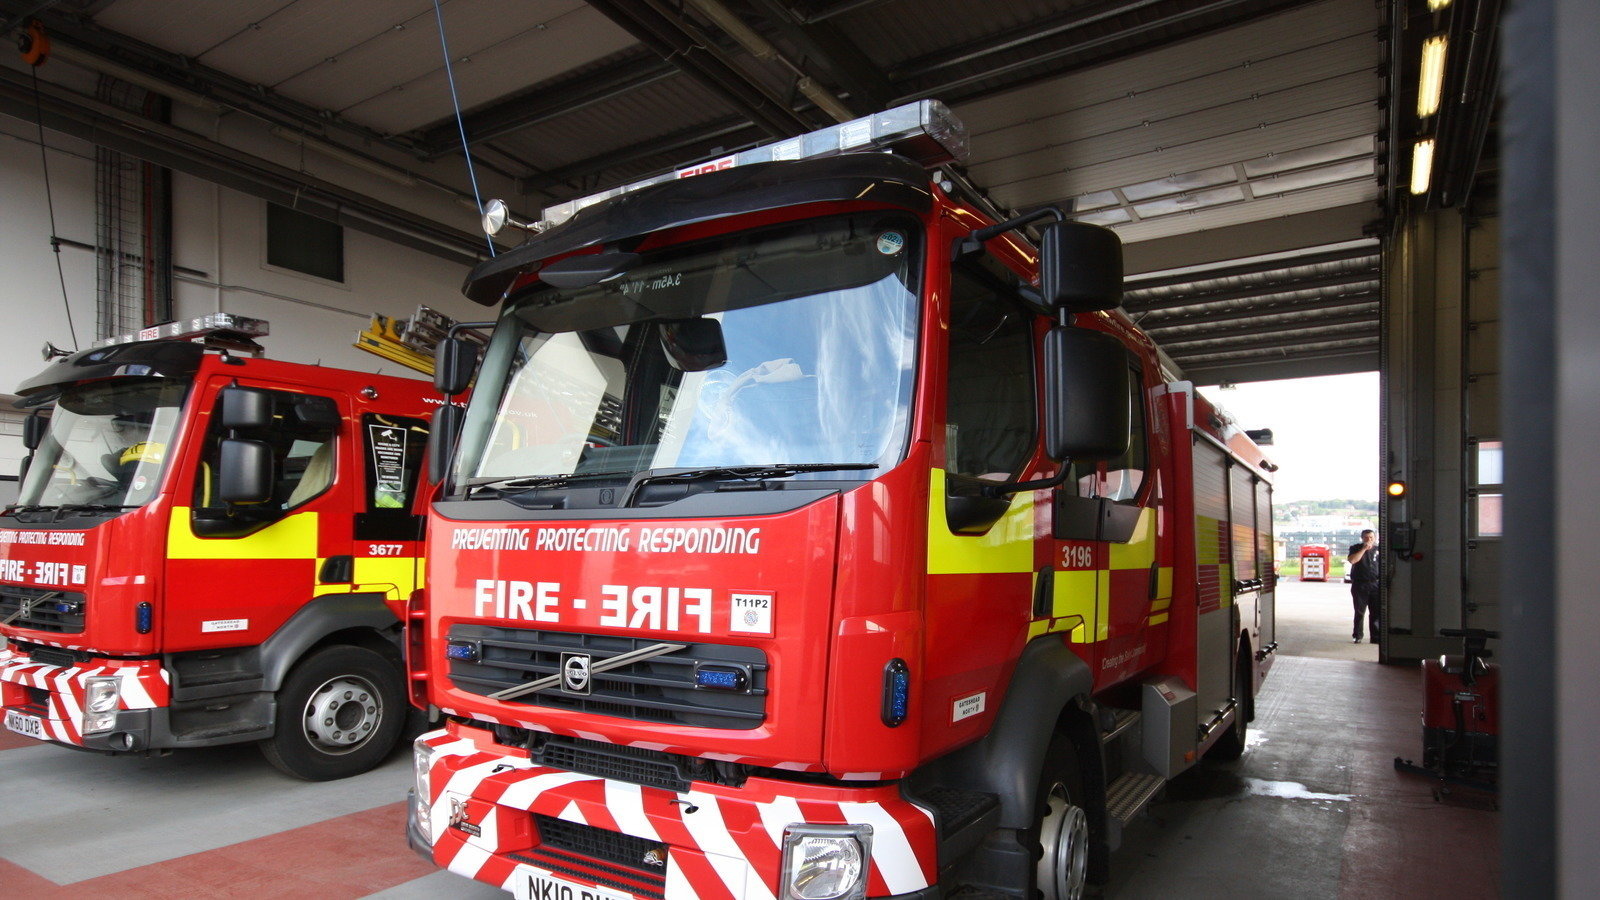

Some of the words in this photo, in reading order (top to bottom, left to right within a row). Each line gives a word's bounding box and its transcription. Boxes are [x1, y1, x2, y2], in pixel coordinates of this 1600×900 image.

[141, 329, 158, 340] FIRE
[19, 531, 48, 545] PROTECTING
[48, 532, 85, 546] RESPONDING
[451, 528, 530, 550] PREVENTING
[535, 528, 631, 552] PROTECTING
[637, 527, 761, 554] RESPONDING
[368, 544, 403, 556] 3677
[1062, 545, 1092, 567] 3196
[0, 559, 25, 582] FIRE
[475, 578, 561, 623] FIRE
[735, 598, 768, 608] T11P2
